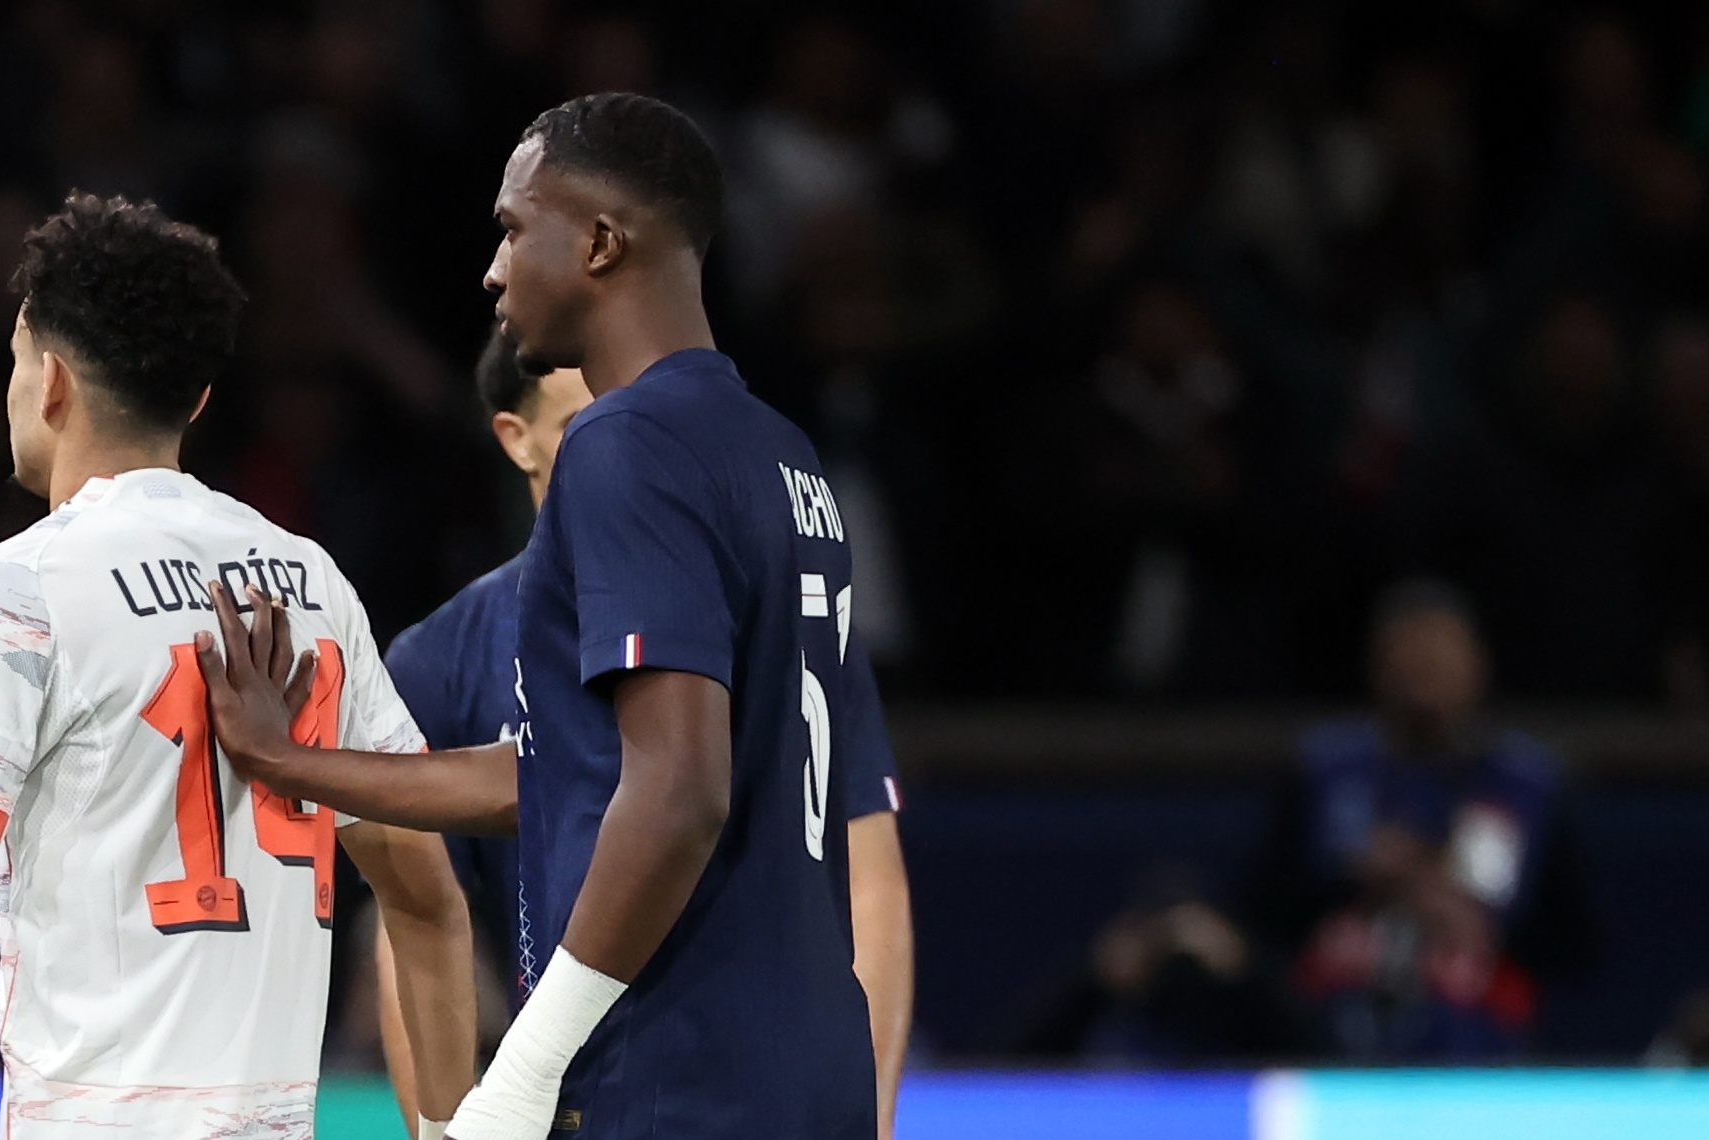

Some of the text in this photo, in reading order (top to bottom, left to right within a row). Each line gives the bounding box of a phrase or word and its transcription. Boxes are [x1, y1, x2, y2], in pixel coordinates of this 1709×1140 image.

[110, 547, 324, 618] LUIS DÍAZ
[138, 637, 347, 936] 14
